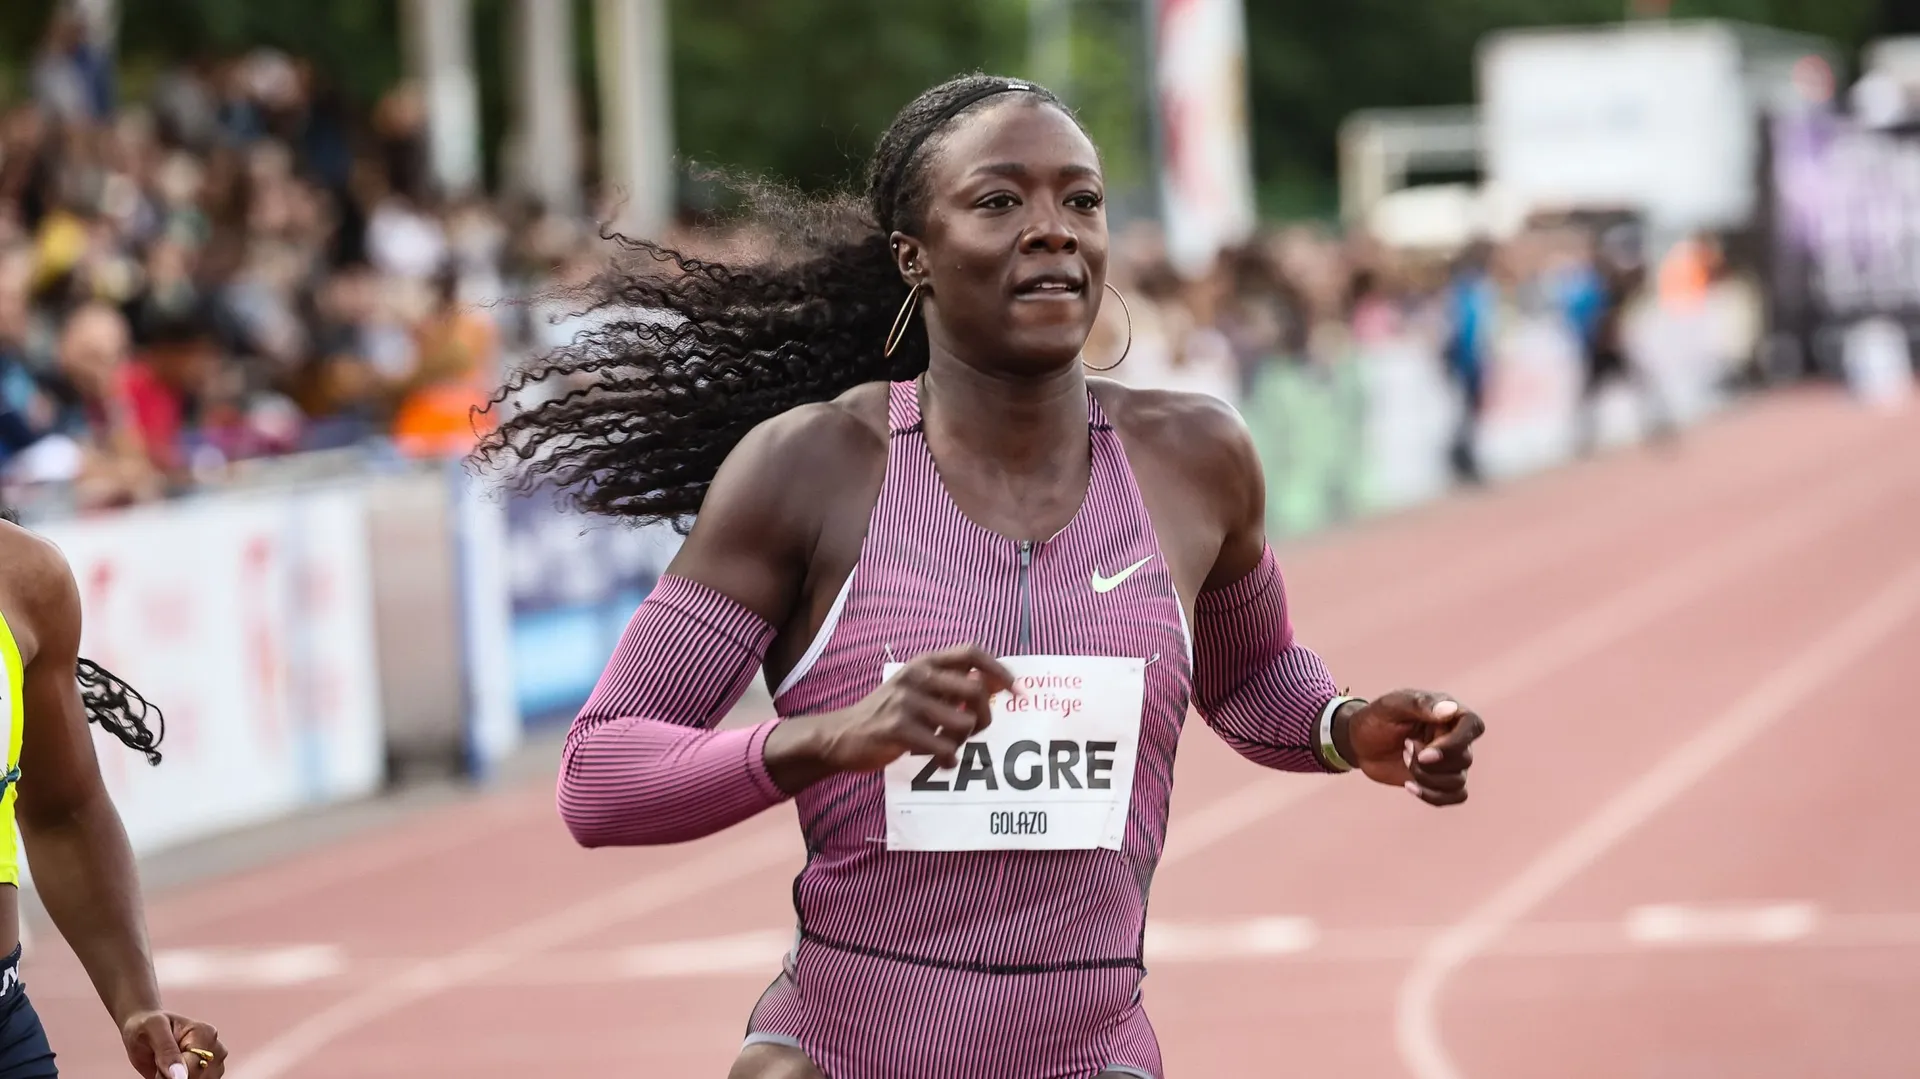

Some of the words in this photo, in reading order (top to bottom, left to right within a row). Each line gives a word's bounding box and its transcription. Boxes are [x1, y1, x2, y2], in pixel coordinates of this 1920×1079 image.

[1016, 670, 1082, 689] rovince
[1006, 693, 1029, 712] de
[910, 740, 1117, 791] ZAGRE
[990, 811, 1047, 835] GOLAZO
